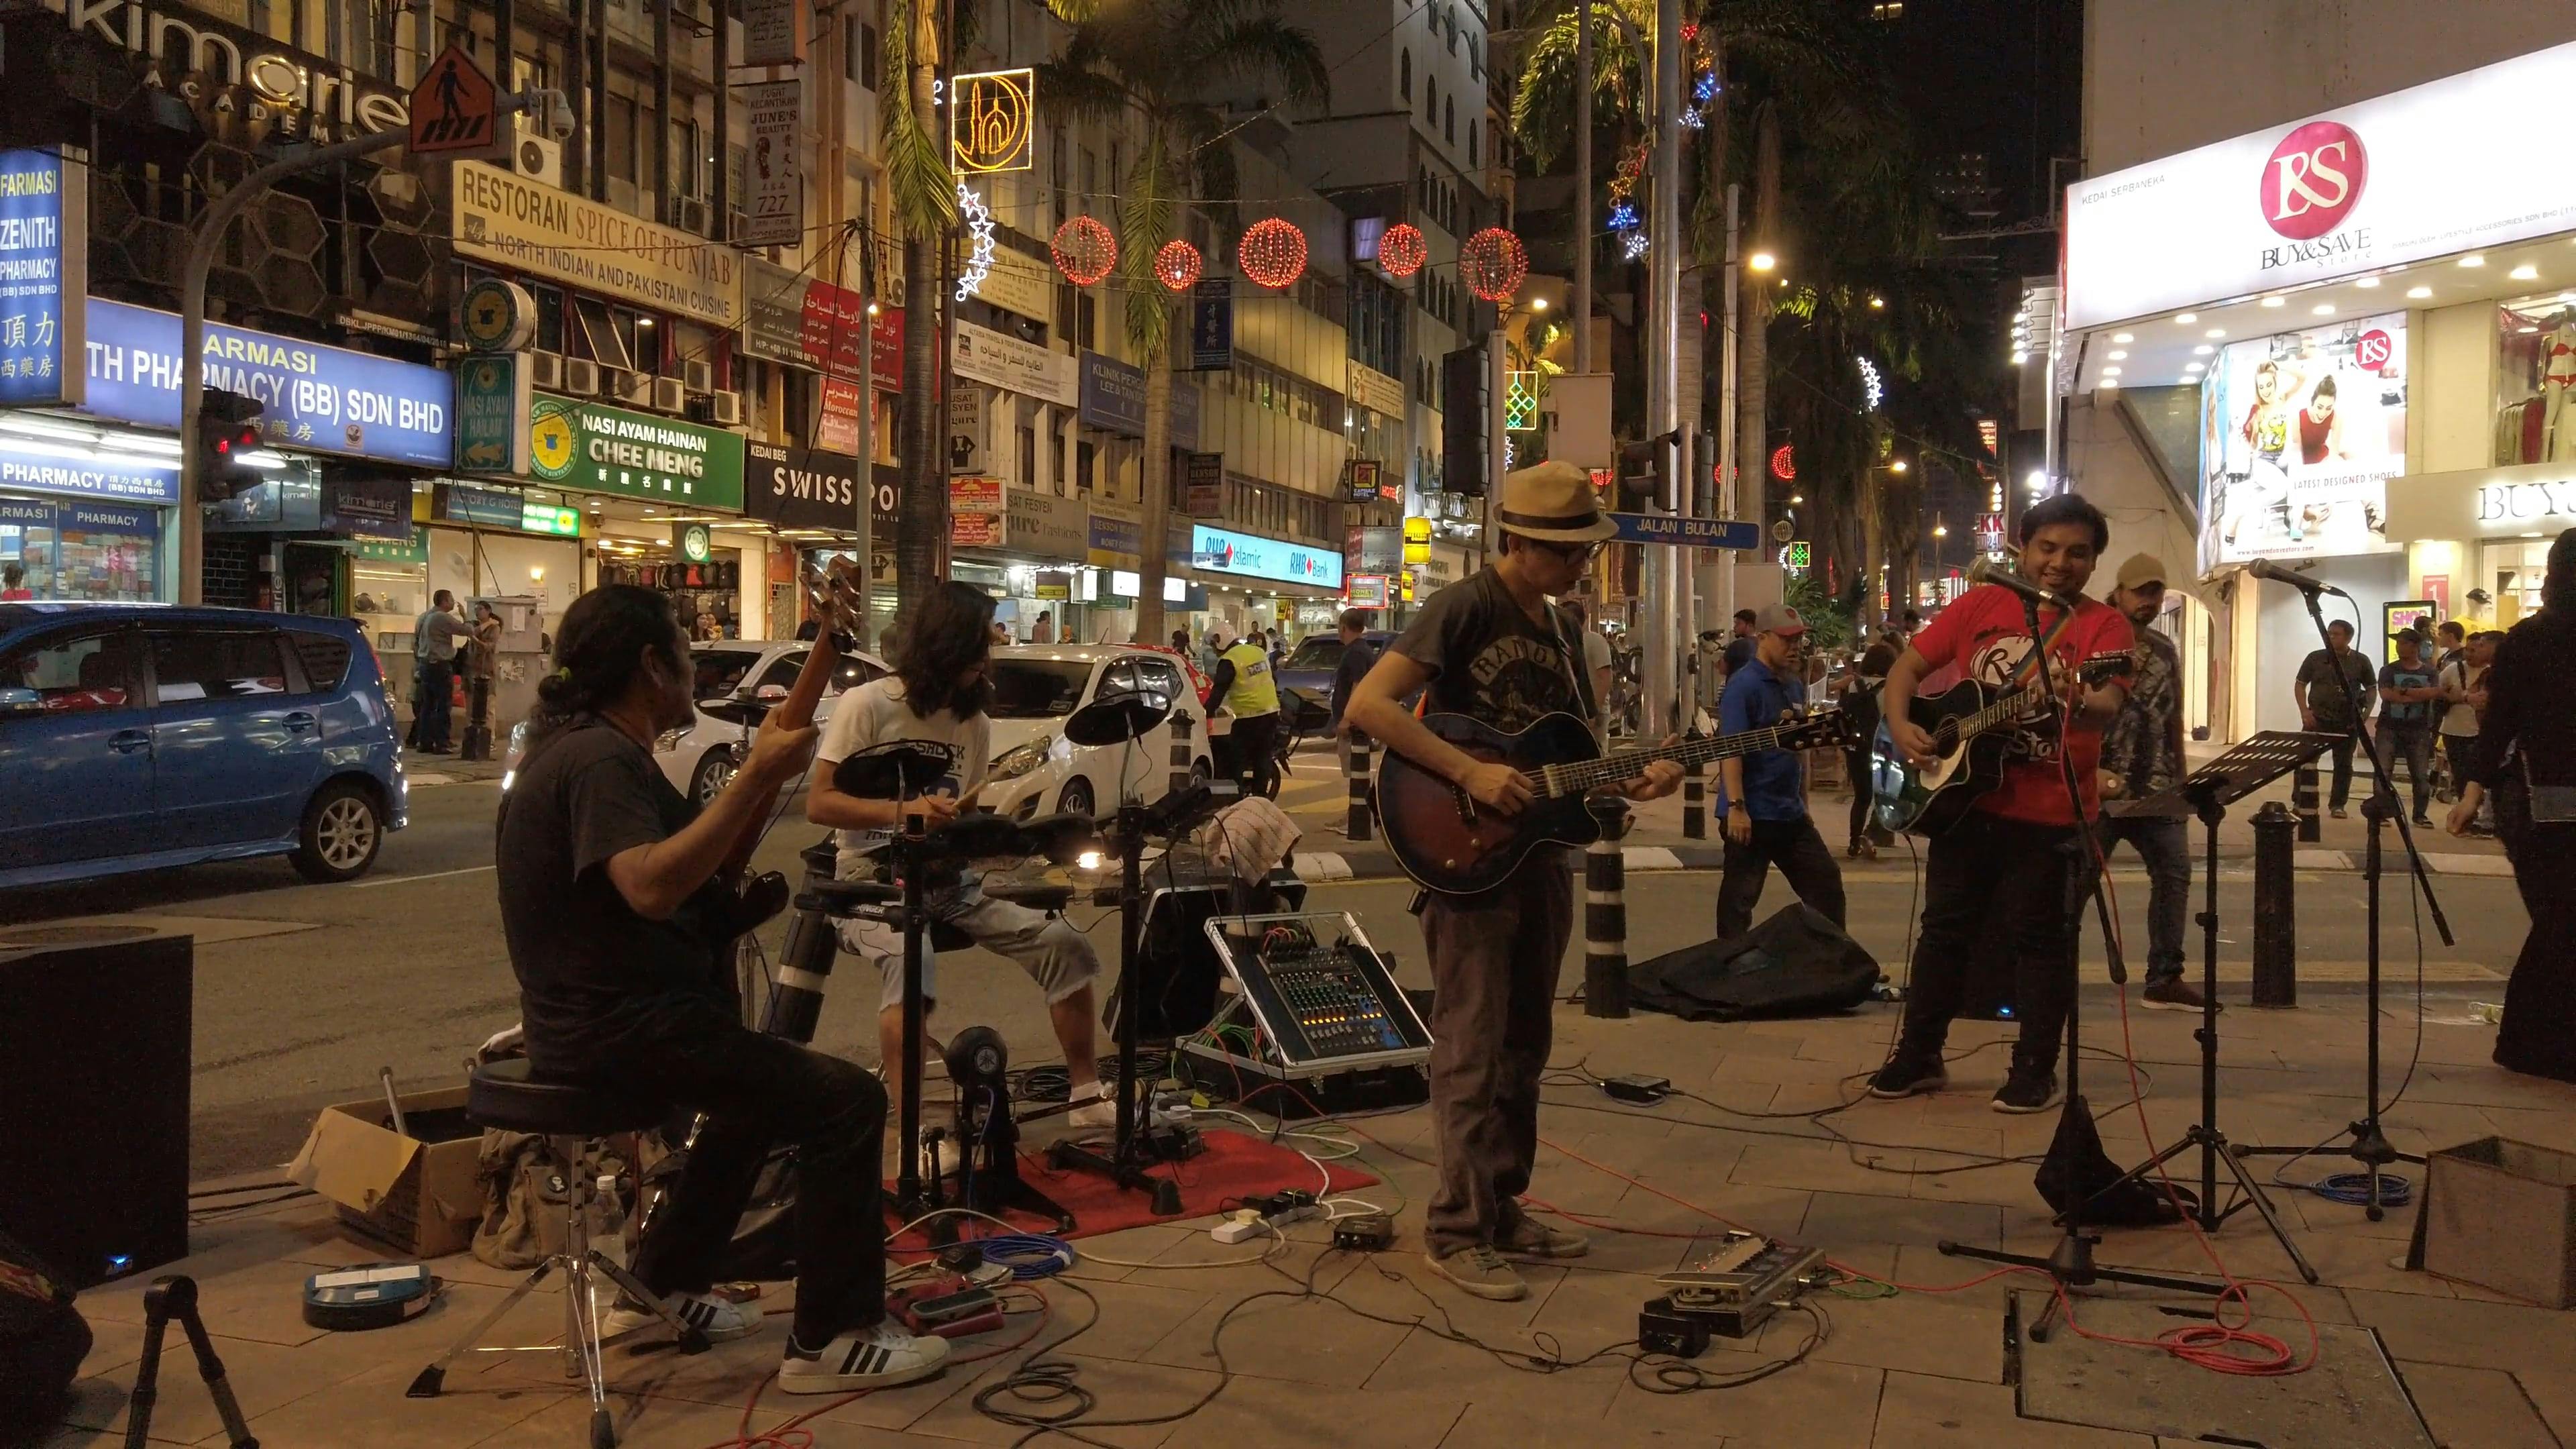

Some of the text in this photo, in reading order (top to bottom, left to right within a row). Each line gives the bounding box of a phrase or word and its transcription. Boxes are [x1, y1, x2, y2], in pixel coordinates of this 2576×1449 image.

[751, 110, 797, 125] JUNE'S
[756, 124, 792, 135] BEAUTY
[0, 170, 56, 197] FARMASI
[2082, 174, 2165, 205] KEDAI SERBANEKA
[757, 195, 789, 213] 727
[463, 167, 731, 286] RESTORAN SPICE OF PUNJAB
[2475, 217, 2523, 231] ACCESSORIES
[2524, 213, 2540, 222] SDN
[2542, 209, 2557, 219] BHD
[0, 215, 56, 251] ZENITH
[2317, 250, 2371, 268] Store
[0, 258, 56, 281] PHARMACY
[494, 231, 730, 319] NORTH INDIAN AND PAKISTANI CUISINE
[0, 284, 56, 299] (BB) SDN BHD
[203, 334, 316, 375] ARMASI
[1092, 363, 1120, 382] KLINIK
[133, 349, 285, 408] PHAMACY
[291, 377, 339, 426] (BB)
[346, 393, 392, 427] SDN
[399, 398, 443, 434] BHD
[1100, 380, 1114, 394] LEE
[463, 396, 485, 417] NASI
[824, 397, 858, 417] Moroccan
[951, 394, 973, 402] USAT
[952, 403, 977, 411] SYEN
[244, 417, 316, 441] 西藥房
[951, 417, 977, 425] gure
[582, 413, 707, 453] NASI AYAM HAINAN
[588, 437, 704, 478] CHEE MENG
[751, 443, 787, 462] KEDAI BEG
[3, 462, 105, 490] PHARMACY
[2294, 479, 2320, 490] LATEST
[2324, 475, 2365, 487] DESIGNED
[128, 484, 146, 494] SDN
[147, 486, 165, 496] BHD
[773, 466, 853, 506] SWISS
[488, 497, 497, 507] G
[1007, 496, 1053, 514] SAT FESYEN
[1, 507, 49, 520] RMASI
[77, 511, 138, 527] PHARMACY
[1637, 519, 1727, 537] JALAN BULAN
[1980, 514, 2004, 533] KK
[1205, 536, 1262, 570] RHB Islamic
[1290, 551, 1329, 579] RHB Bank
